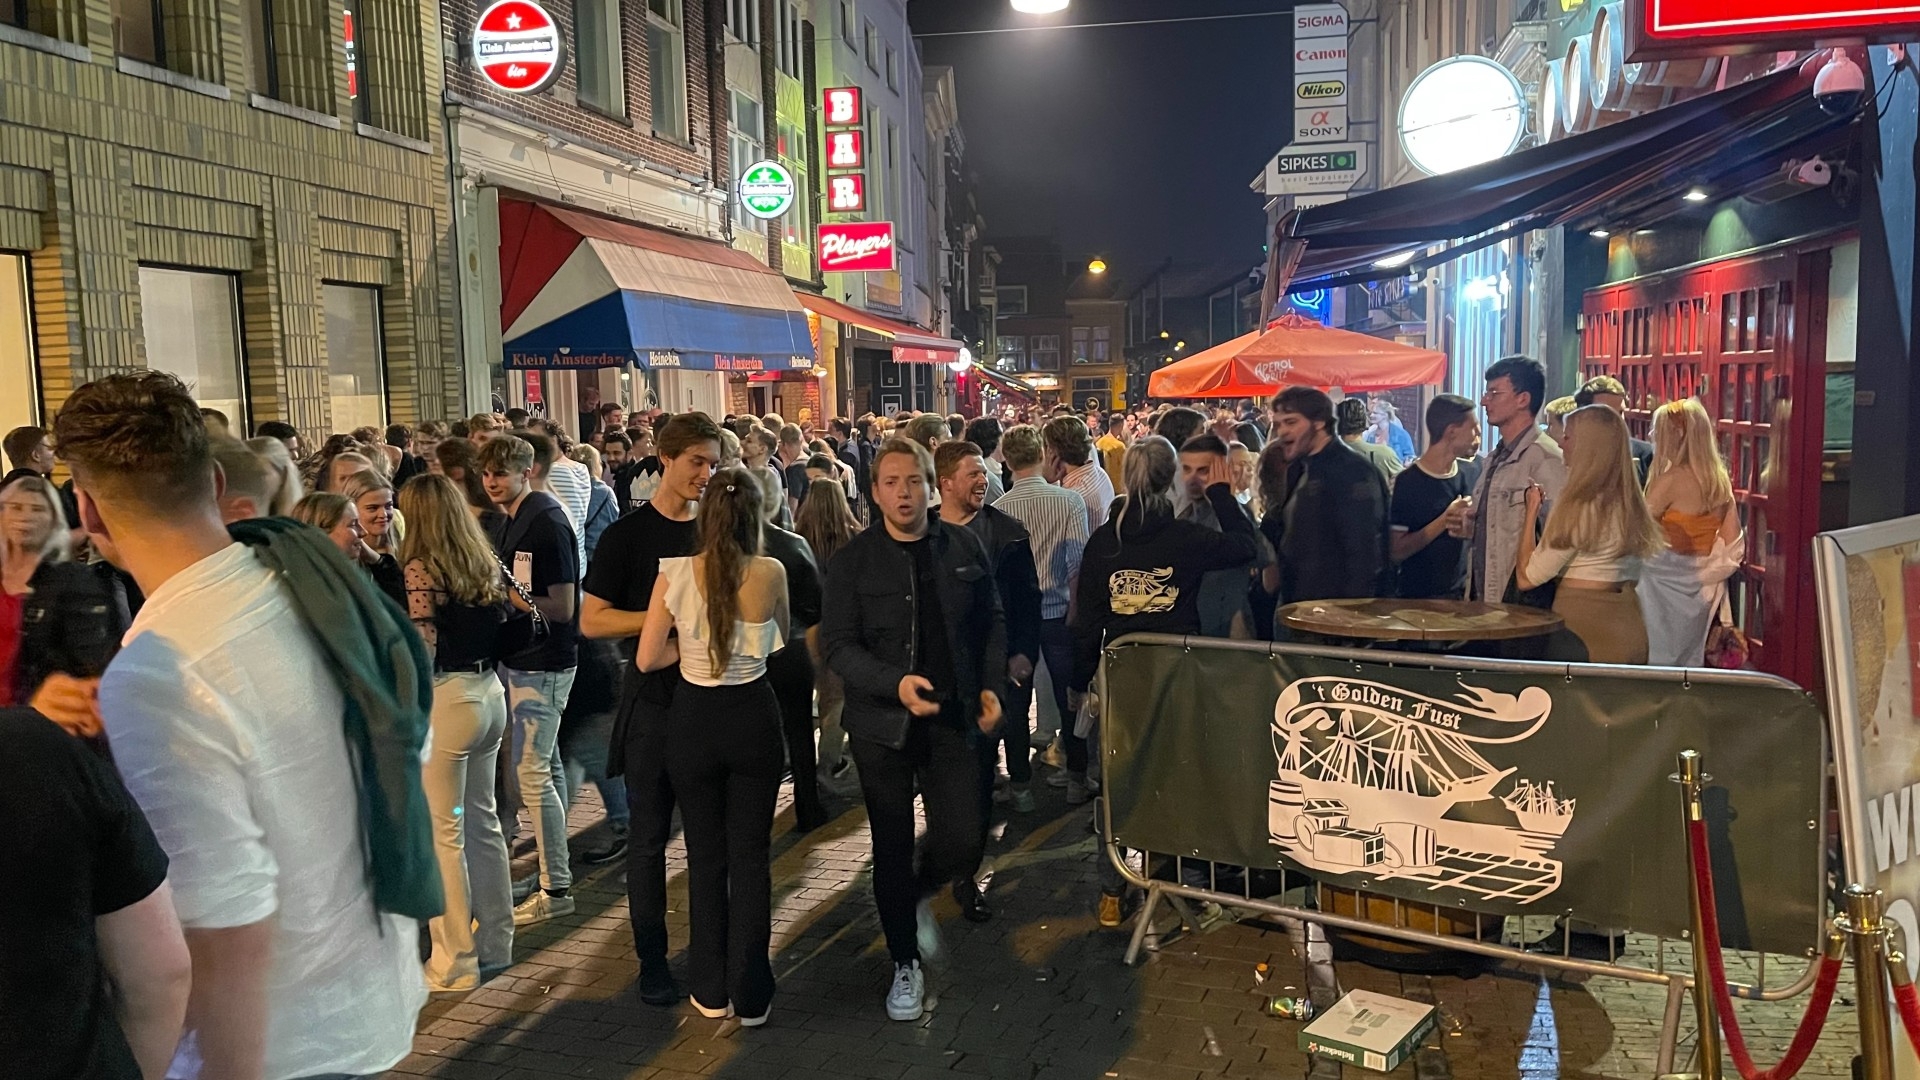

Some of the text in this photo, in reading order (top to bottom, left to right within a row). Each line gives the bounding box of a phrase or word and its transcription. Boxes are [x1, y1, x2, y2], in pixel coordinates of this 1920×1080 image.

[1297, 15, 1344, 29] SIGMA
[481, 40, 551, 53] Klein Amsterdam
[1295, 49, 1346, 61] Canon
[1302, 82, 1341, 96] Nikon
[1299, 126, 1344, 137] SONY
[830, 91, 858, 208] BAR
[1280, 155, 1328, 171] SIPKES
[821, 233, 892, 259] Players
[512, 353, 547, 366] Klein
[649, 351, 681, 366] Heineken
[714, 354, 764, 370] Klein Amsterdam
[1255, 359, 1294, 377] APEROL
[1331, 683, 1402, 711] Golden
[1407, 702, 1462, 730] Fust
[1319, 1045, 1354, 1061] Heineken
